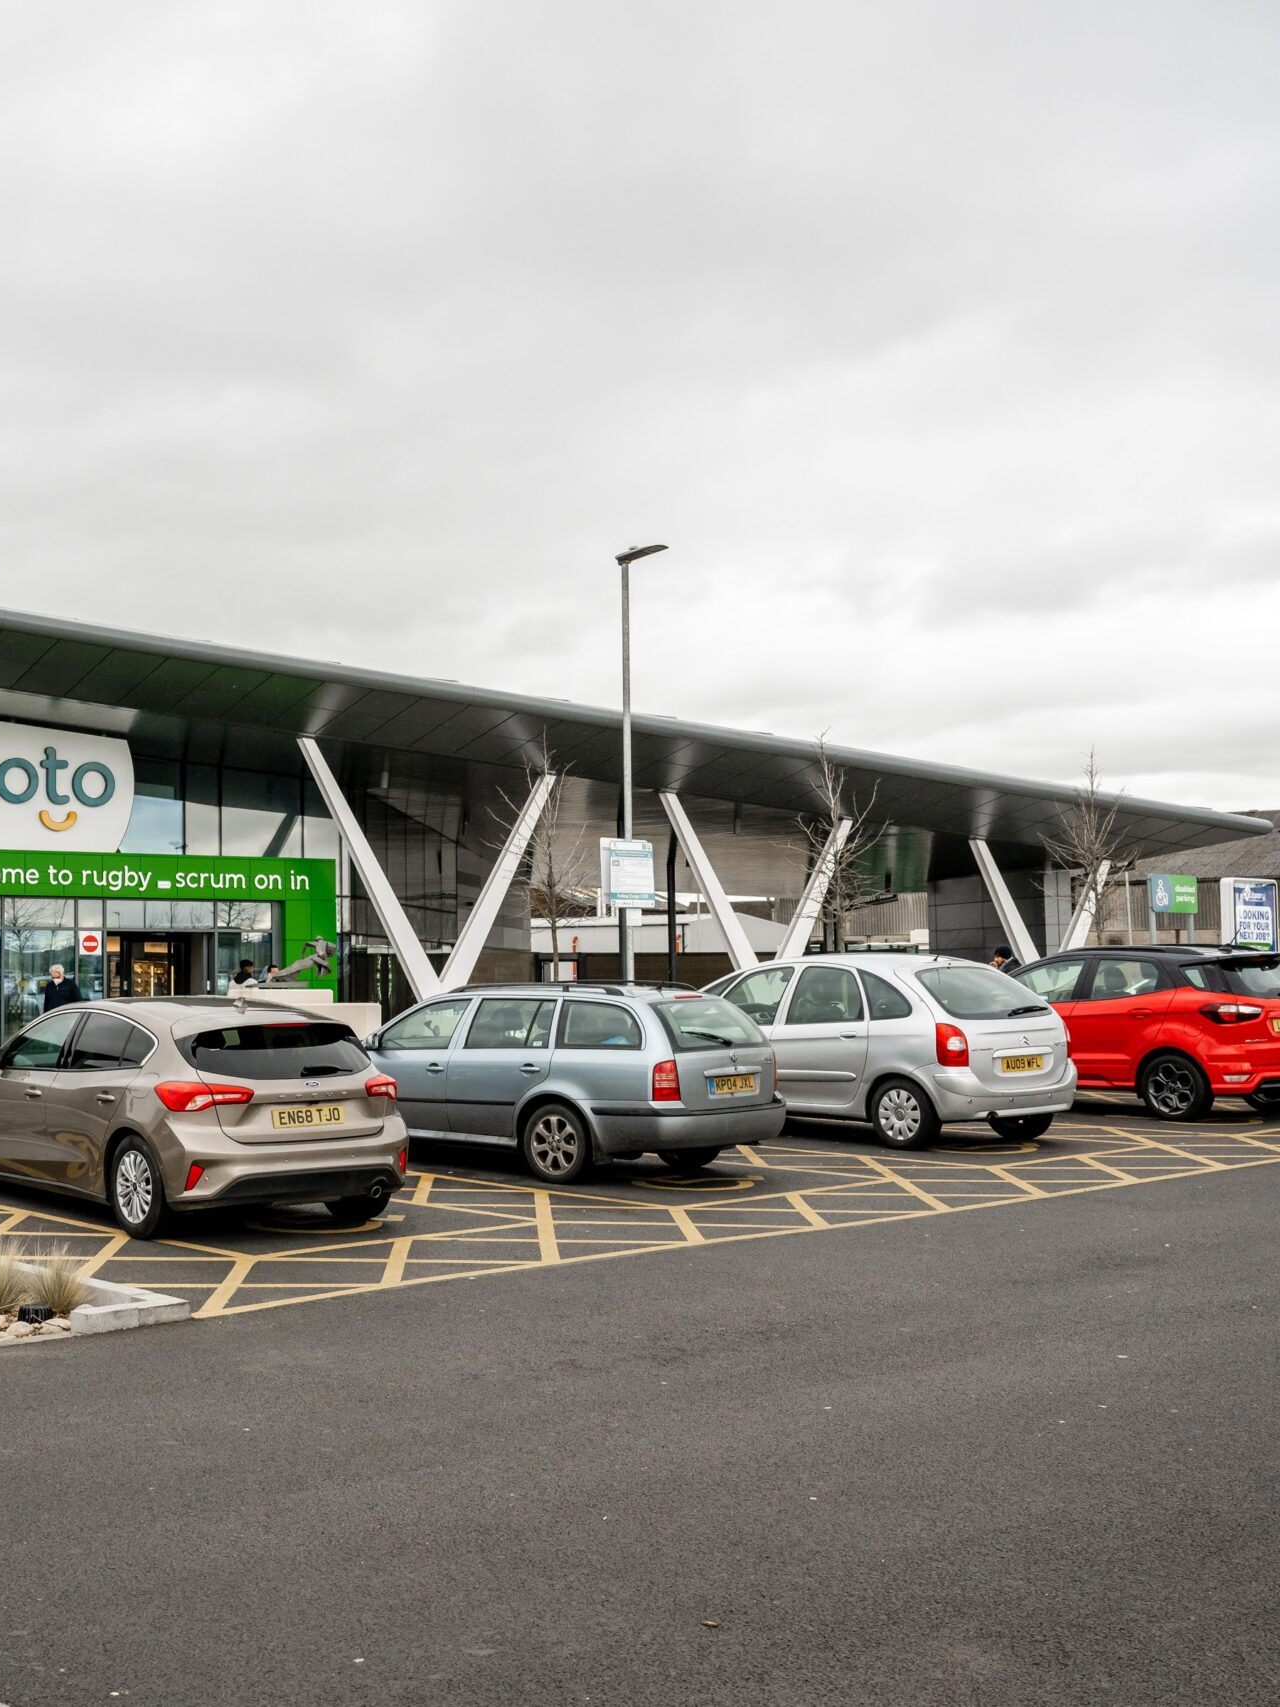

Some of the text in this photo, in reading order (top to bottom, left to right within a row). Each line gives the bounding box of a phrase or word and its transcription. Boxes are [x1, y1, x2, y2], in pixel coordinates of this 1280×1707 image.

[48, 865, 73, 885] to
[81, 865, 152, 891] rugby
[175, 871, 246, 889] scrum
[254, 873, 282, 890] on
[290, 870, 310, 890] in
[1239, 921, 1270, 931] FOR YOUR
[1239, 931, 1270, 941] NEXT JOB?
[1005, 1057, 1041, 1070] AU09 WFL
[715, 1076, 753, 1092] KP04 JXL
[278, 1109, 313, 1126] EN68
